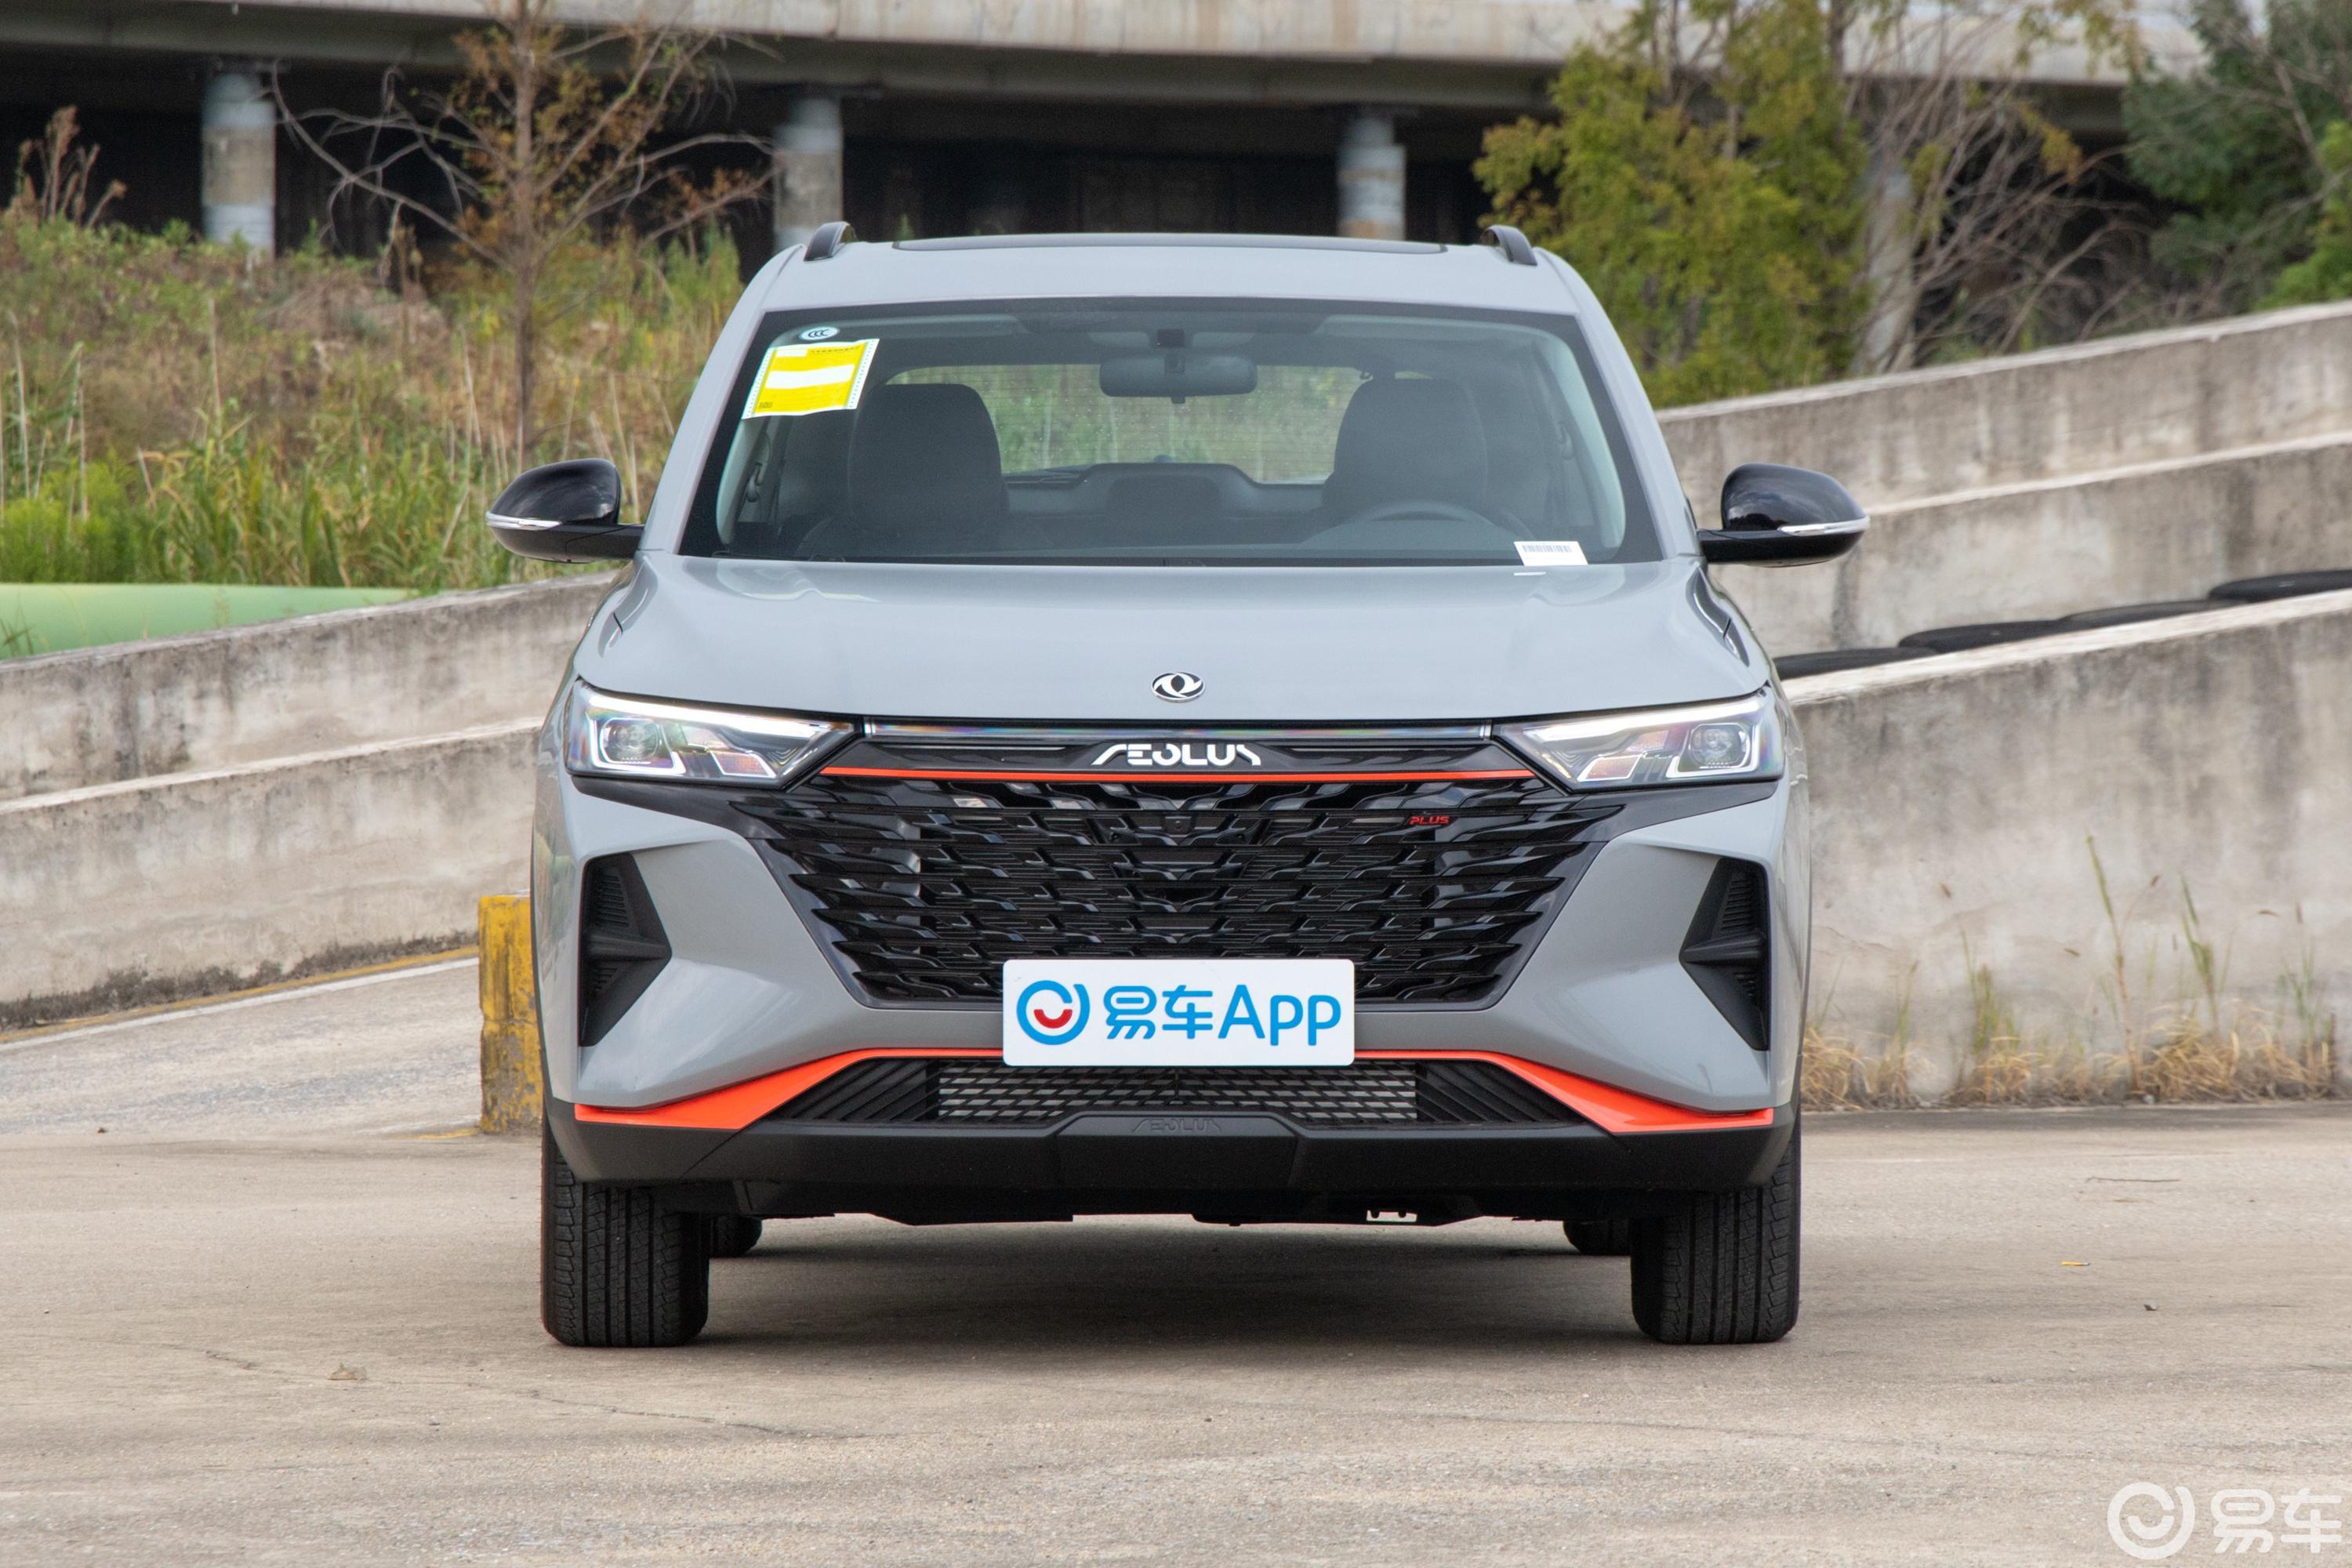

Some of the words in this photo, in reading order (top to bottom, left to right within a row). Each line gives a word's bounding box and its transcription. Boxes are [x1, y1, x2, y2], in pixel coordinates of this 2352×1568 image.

[1091, 743, 1261, 766] AEOLUS
[1408, 815, 1450, 826] PLUS
[1103, 984, 1341, 1047] 易车App
